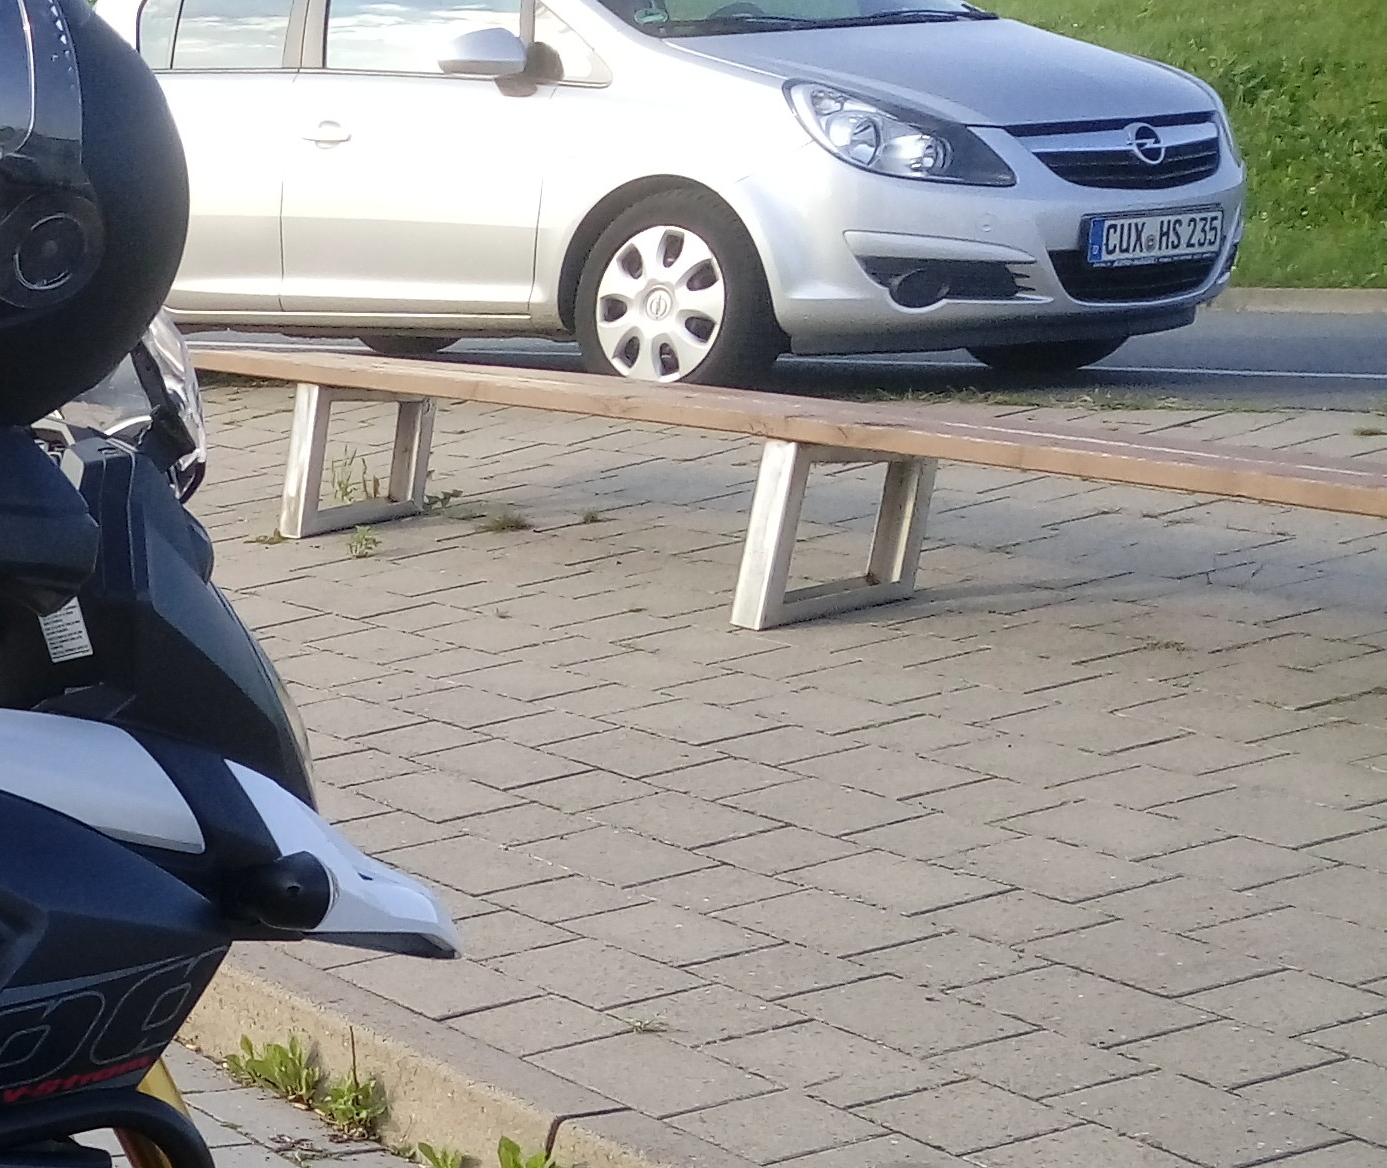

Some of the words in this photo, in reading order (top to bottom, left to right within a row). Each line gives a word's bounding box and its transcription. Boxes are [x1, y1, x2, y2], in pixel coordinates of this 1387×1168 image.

[1105, 222, 1146, 255] CUX
[1158, 219, 1183, 250] HS
[1186, 216, 1219, 248] 235
